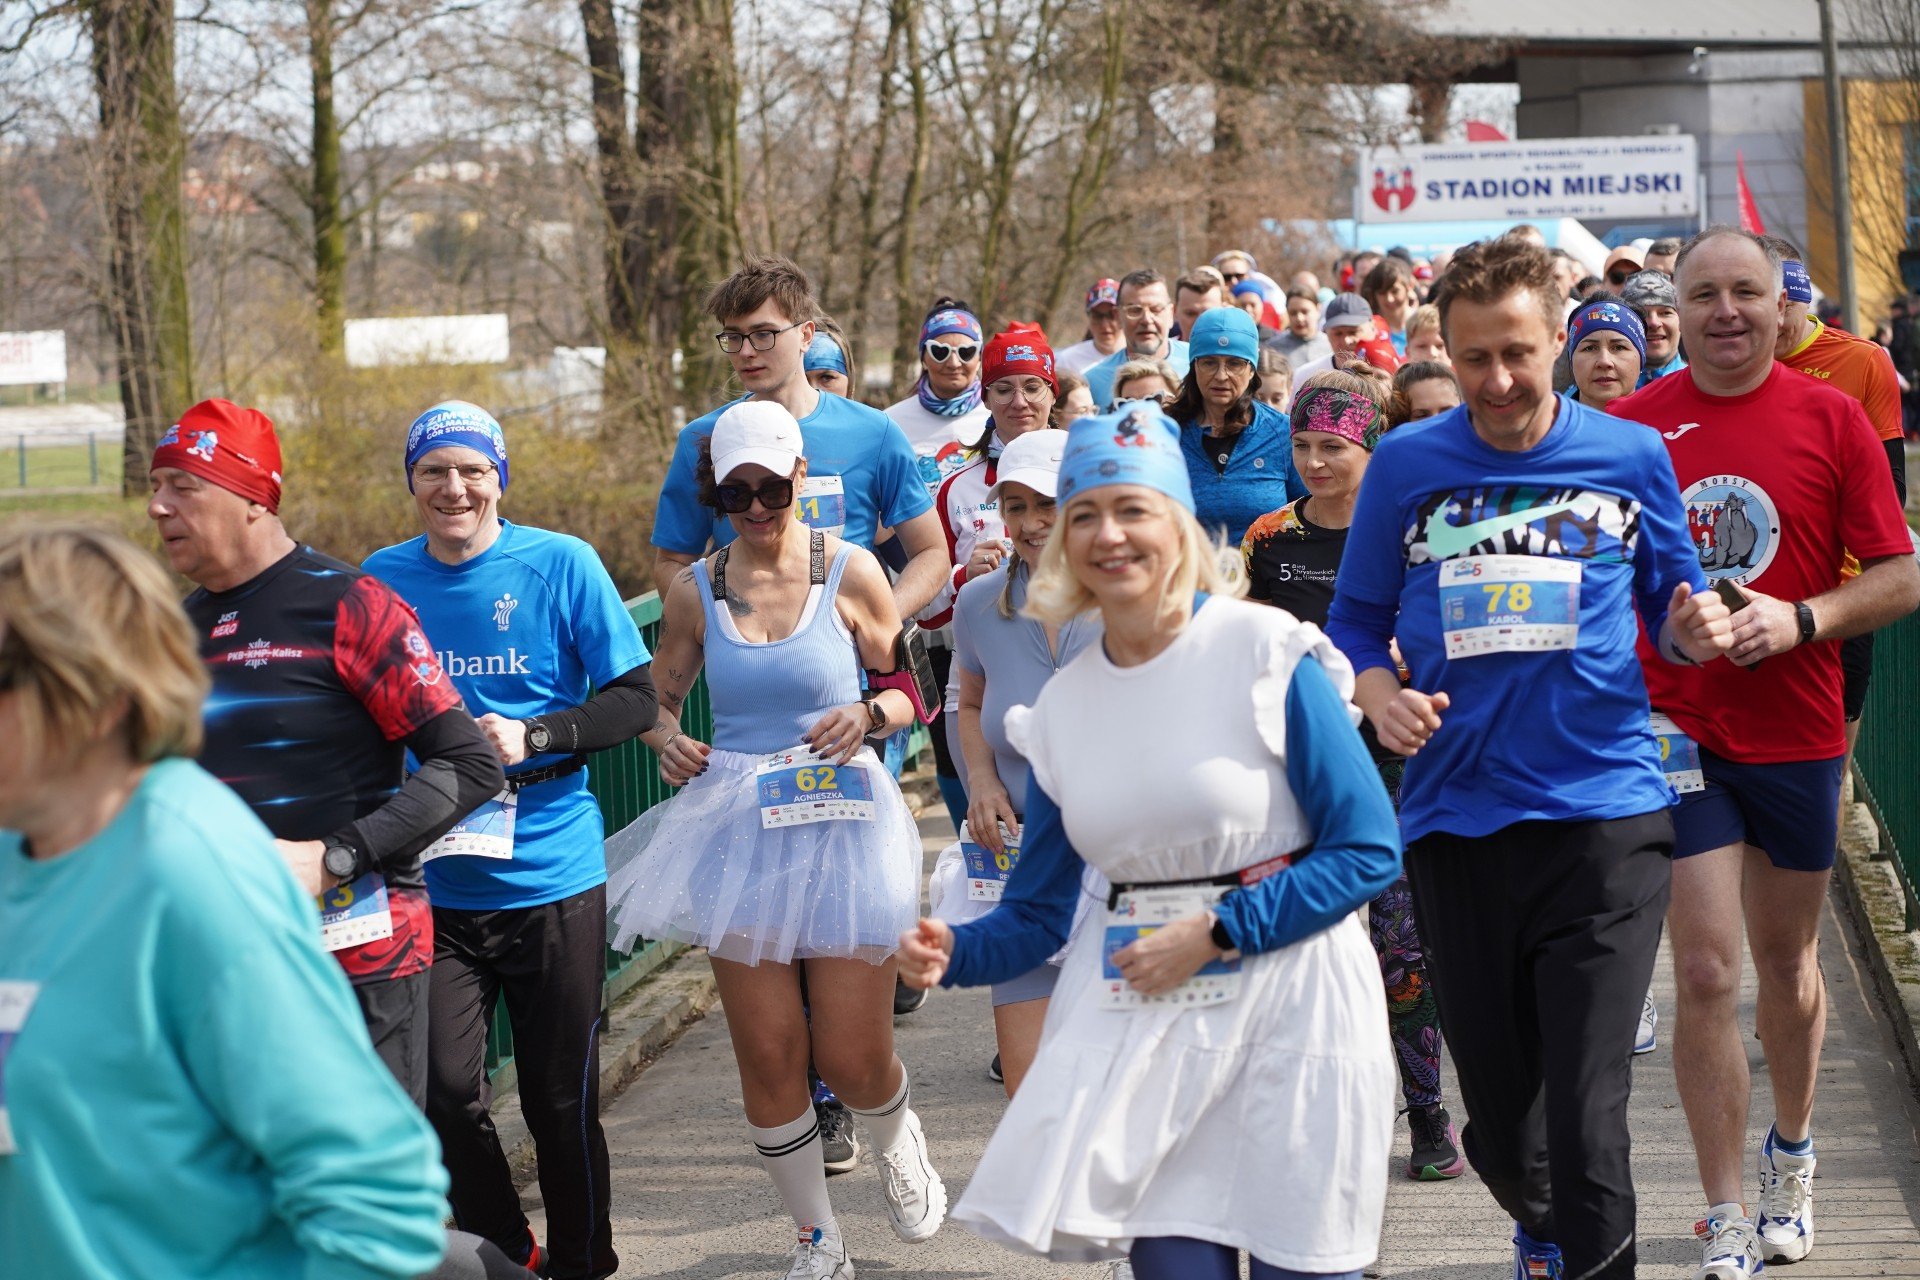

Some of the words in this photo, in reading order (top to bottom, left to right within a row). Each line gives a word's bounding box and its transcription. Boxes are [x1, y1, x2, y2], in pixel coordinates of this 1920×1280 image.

[1426, 177, 1552, 201] STADION
[1562, 172, 1682, 196] MIEJSKI
[1700, 476, 1749, 489] MORSY
[811, 551, 824, 581] NEVER
[1279, 563, 1292, 581] 5
[1482, 582, 1533, 613] 78
[218, 610, 239, 624] JUST
[1487, 615, 1526, 625] KAROL
[212, 622, 238, 637] HERO
[795, 766, 838, 792] 62
[793, 792, 845, 803] AGNIESZKA
[1694, 1220, 1708, 1233] 239
